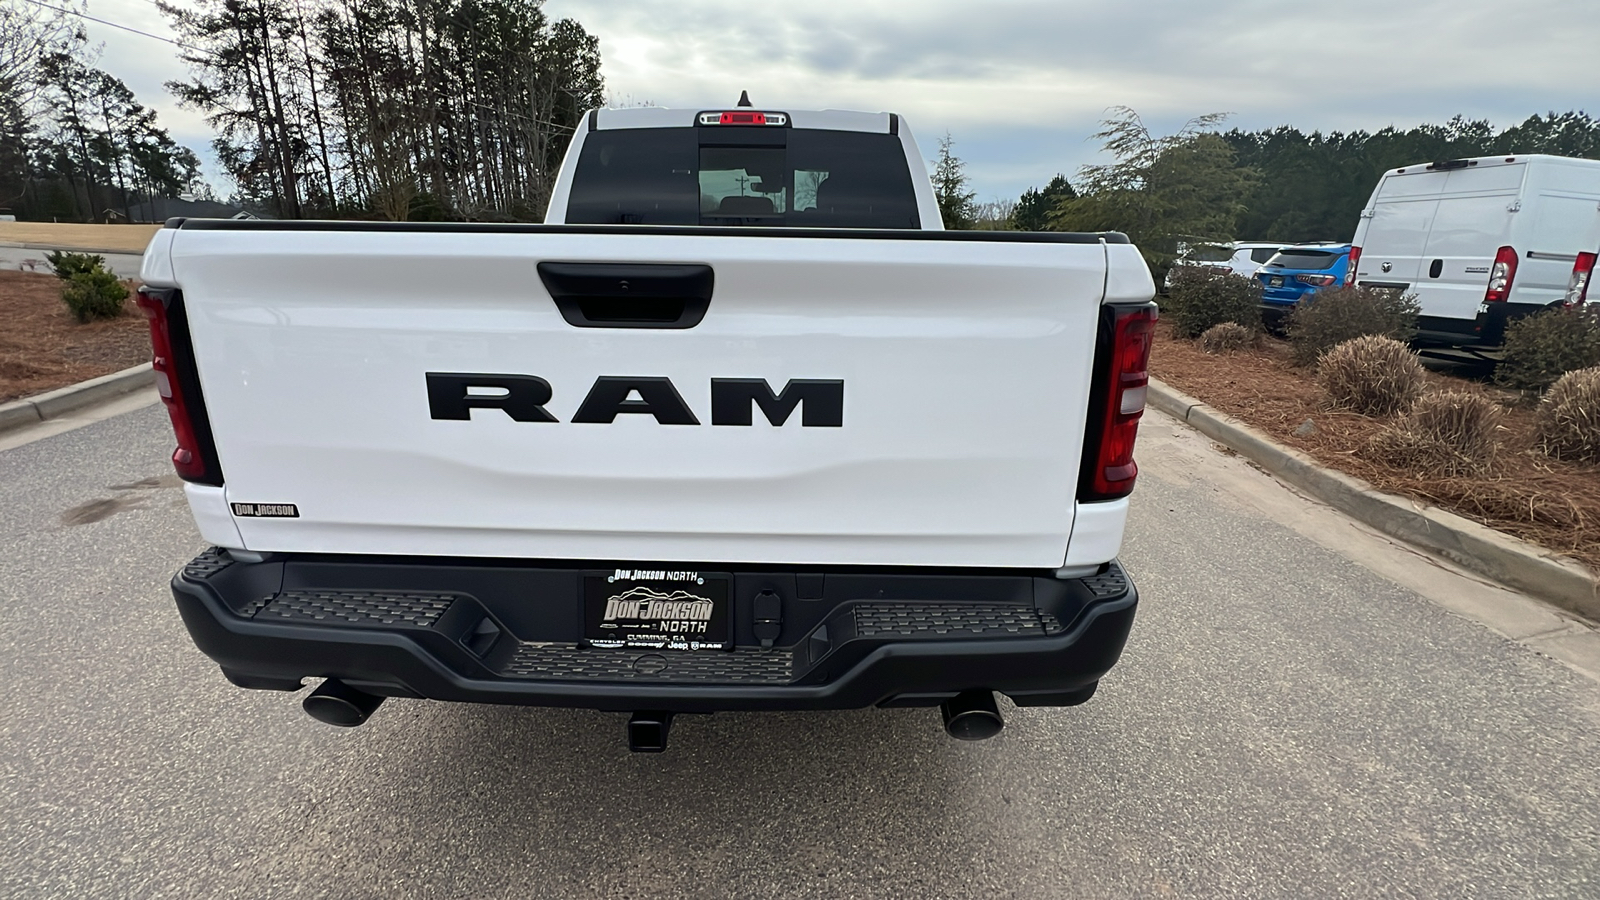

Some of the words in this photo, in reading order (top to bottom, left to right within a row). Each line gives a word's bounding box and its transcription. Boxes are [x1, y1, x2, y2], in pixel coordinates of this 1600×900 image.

[425, 371, 845, 427] RAM
[234, 503, 254, 515] DON
[255, 504, 294, 516] JACKSON
[614, 569, 631, 580] DON
[631, 569, 666, 581] JACKSON
[666, 571, 698, 581] NORTH
[603, 599, 640, 620] DON
[639, 601, 713, 620] JACKSON
[660, 621, 707, 632] NORTH
[667, 641, 689, 650] Jeep
